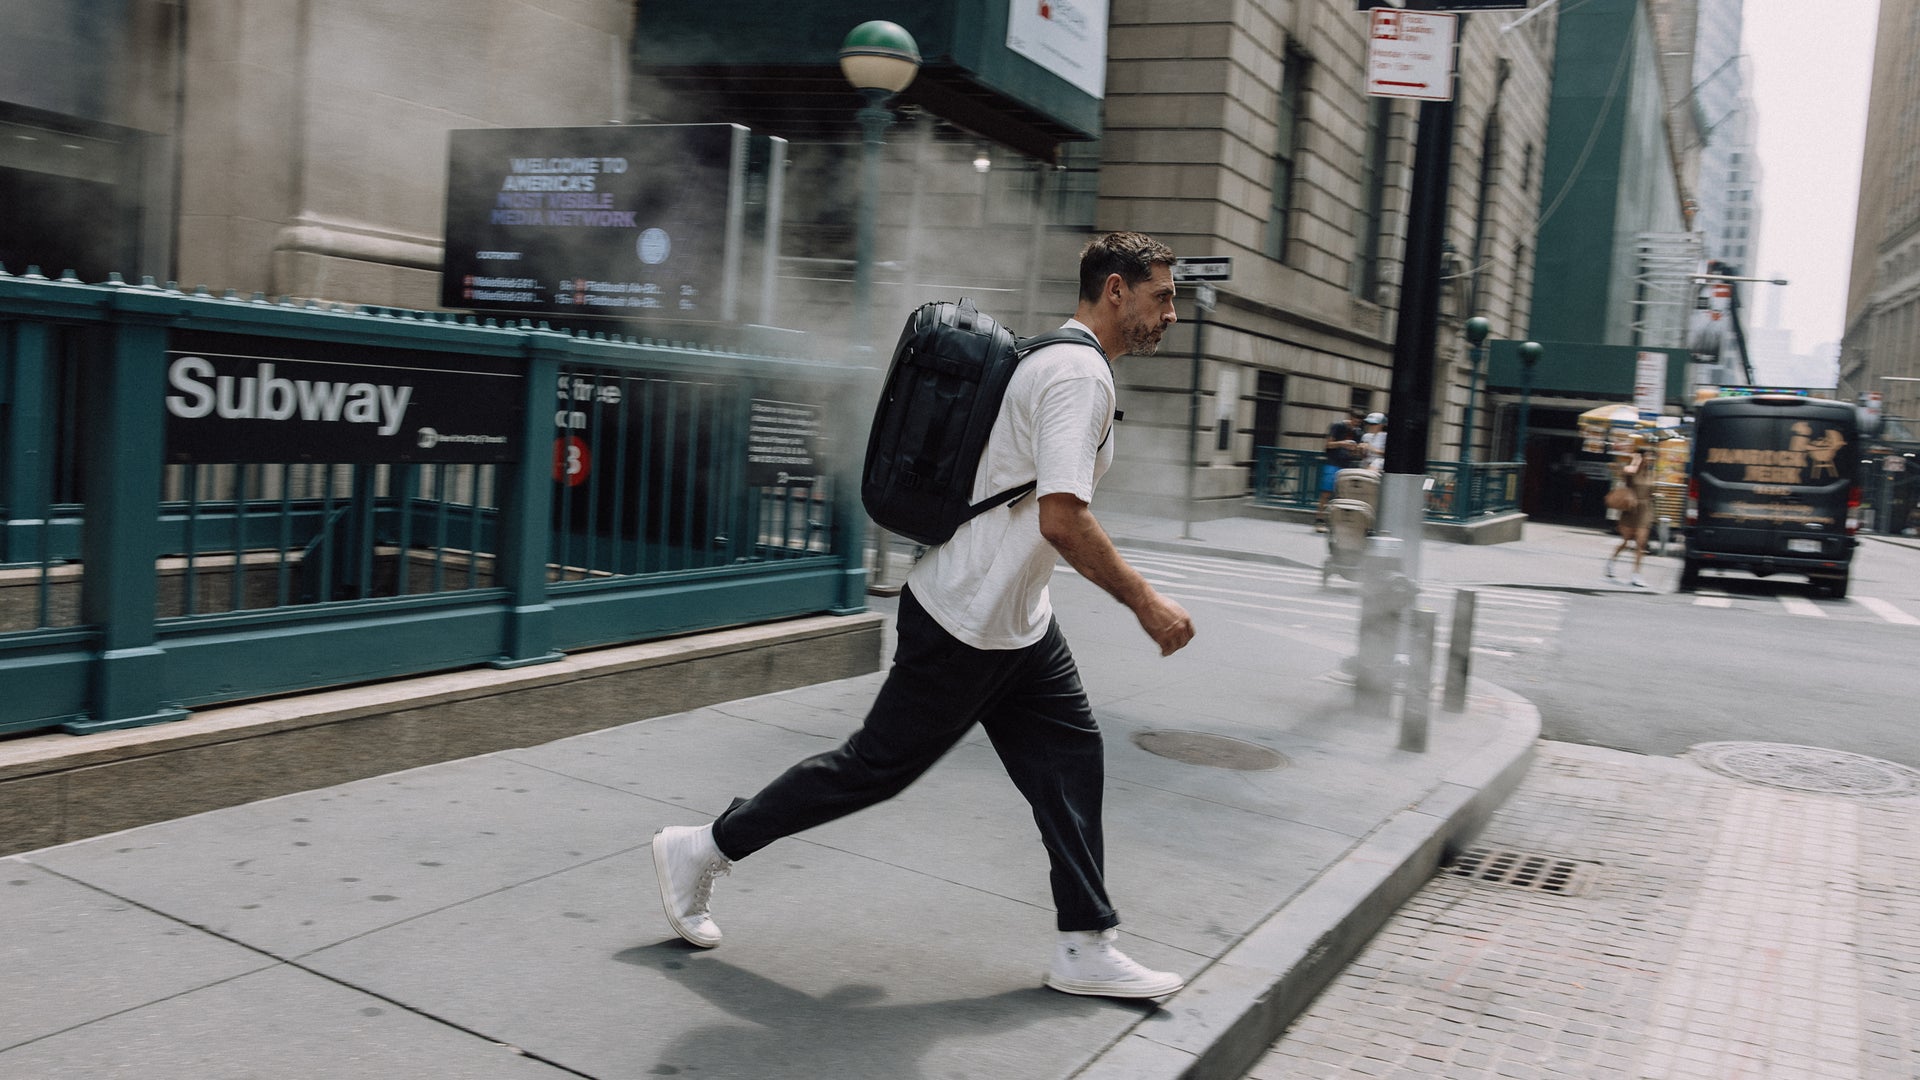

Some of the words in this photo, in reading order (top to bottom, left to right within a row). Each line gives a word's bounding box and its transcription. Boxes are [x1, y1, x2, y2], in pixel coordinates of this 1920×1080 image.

[510, 157, 599, 174] WELCOME
[601, 157, 628, 174] TO
[501, 175, 596, 191] AMERICA'S
[497, 192, 544, 209] MOST
[547, 192, 614, 209] VISIBLE
[490, 209, 545, 225] MEDIA
[547, 210, 638, 228] NETWORK
[165, 356, 413, 437] Subway
